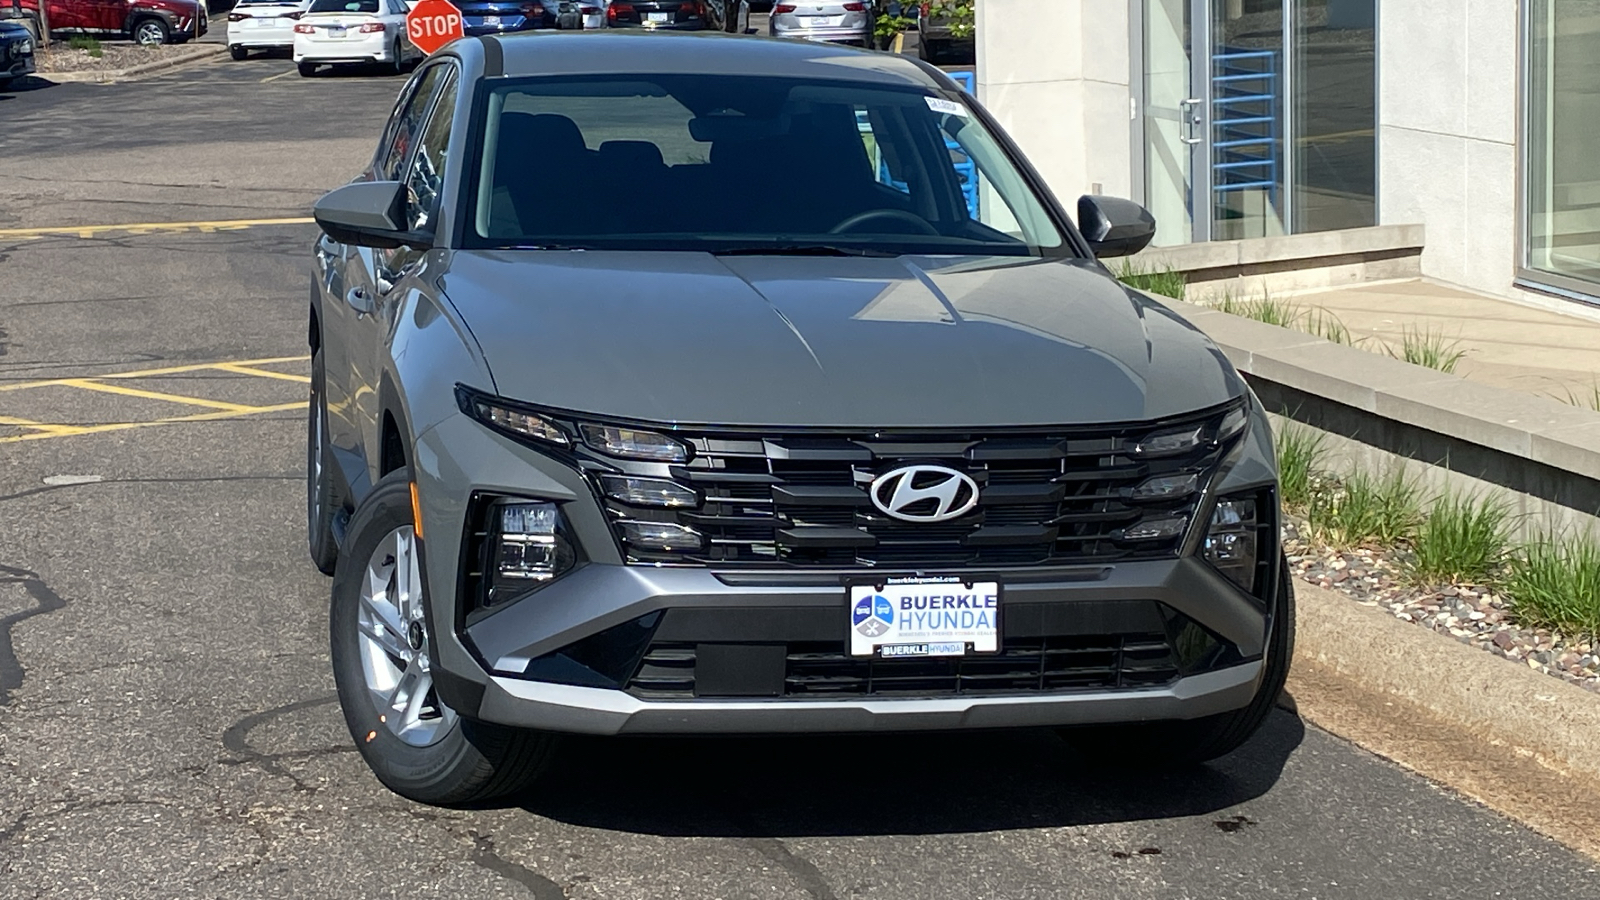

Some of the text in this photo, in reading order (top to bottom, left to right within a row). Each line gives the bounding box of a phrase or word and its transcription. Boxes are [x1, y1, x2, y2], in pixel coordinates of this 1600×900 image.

[411, 14, 459, 38] STOP
[900, 595, 997, 610] BUERKLE
[899, 610, 997, 630] HYUNDAI
[883, 643, 963, 655] BUERKLE HYUNDAI
